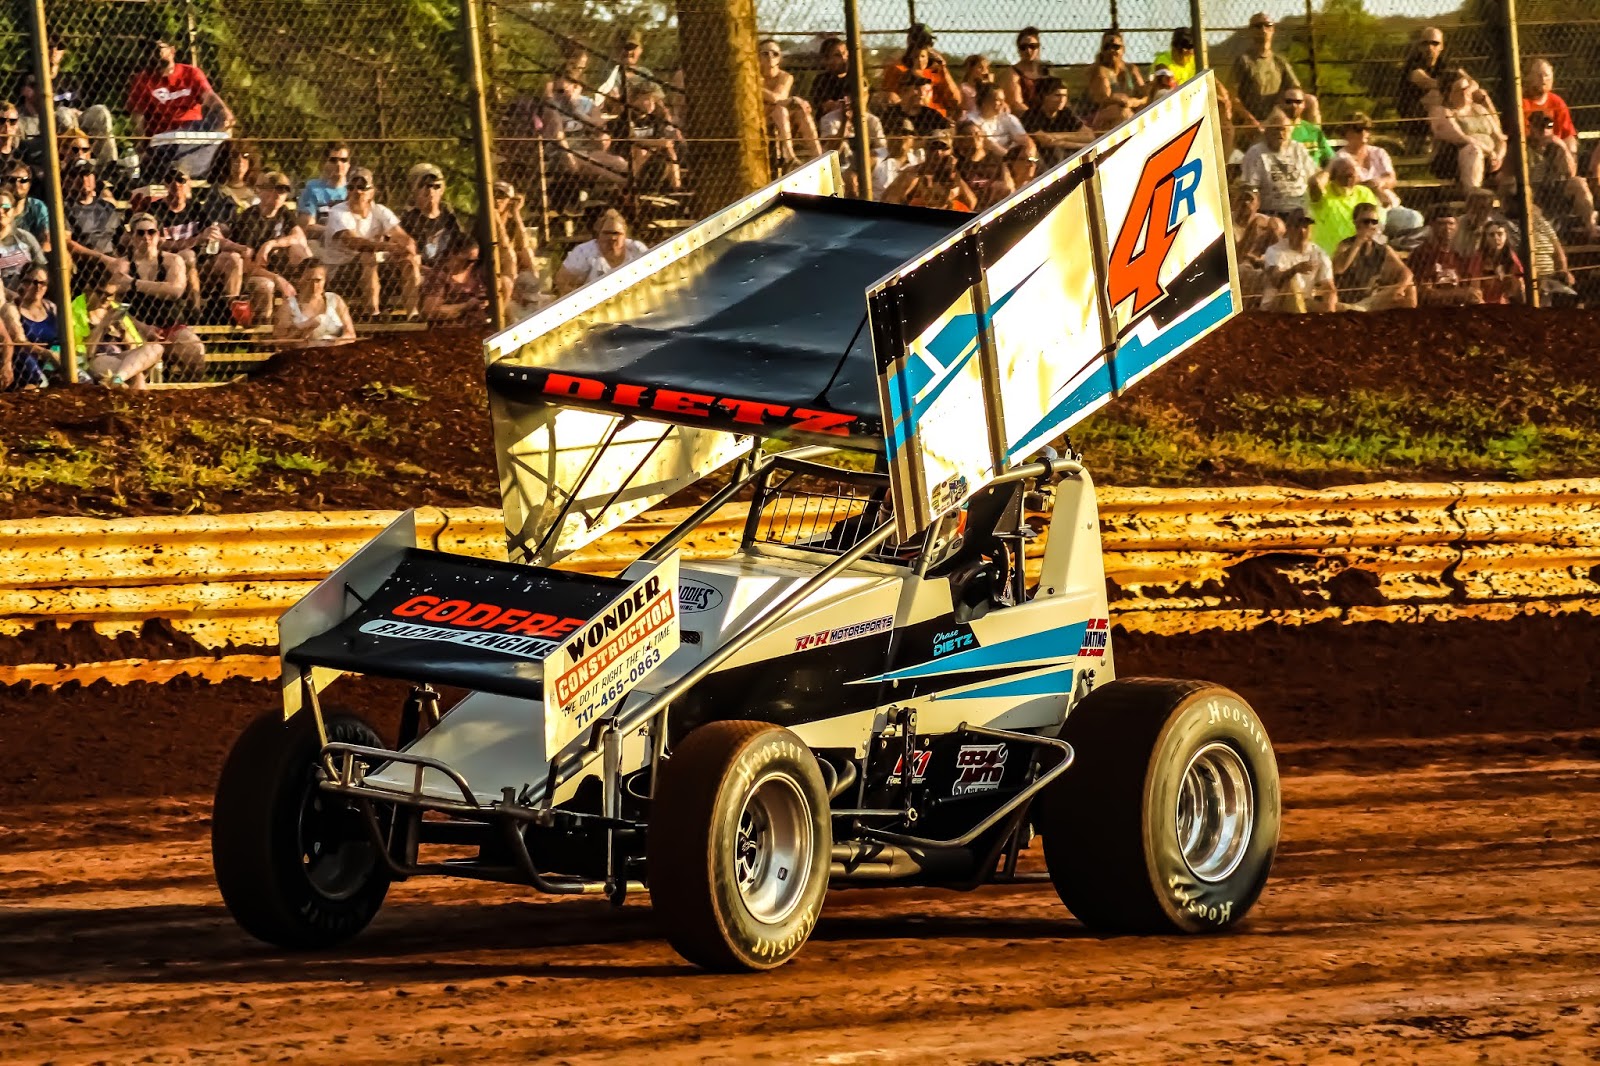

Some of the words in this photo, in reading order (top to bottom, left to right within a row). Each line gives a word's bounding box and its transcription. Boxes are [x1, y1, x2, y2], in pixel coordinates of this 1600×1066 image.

[542, 373, 858, 436] DIETZ
[369, 623, 464, 640] RACING
[392, 595, 588, 637] GODFRE
[566, 575, 660, 663] WONDER
[830, 615, 894, 643] MOTORSPORTS
[933, 629, 959, 645] Chase
[557, 594, 673, 702] CONSTRUCTION
[933, 633, 973, 657] DIETZ
[575, 648, 661, 729] 717-465-0863
[579, 690, 590, 706] DO
[591, 681, 600, 695] IT
[601, 663, 624, 690] RIGHT
[626, 650, 640, 669] THE
